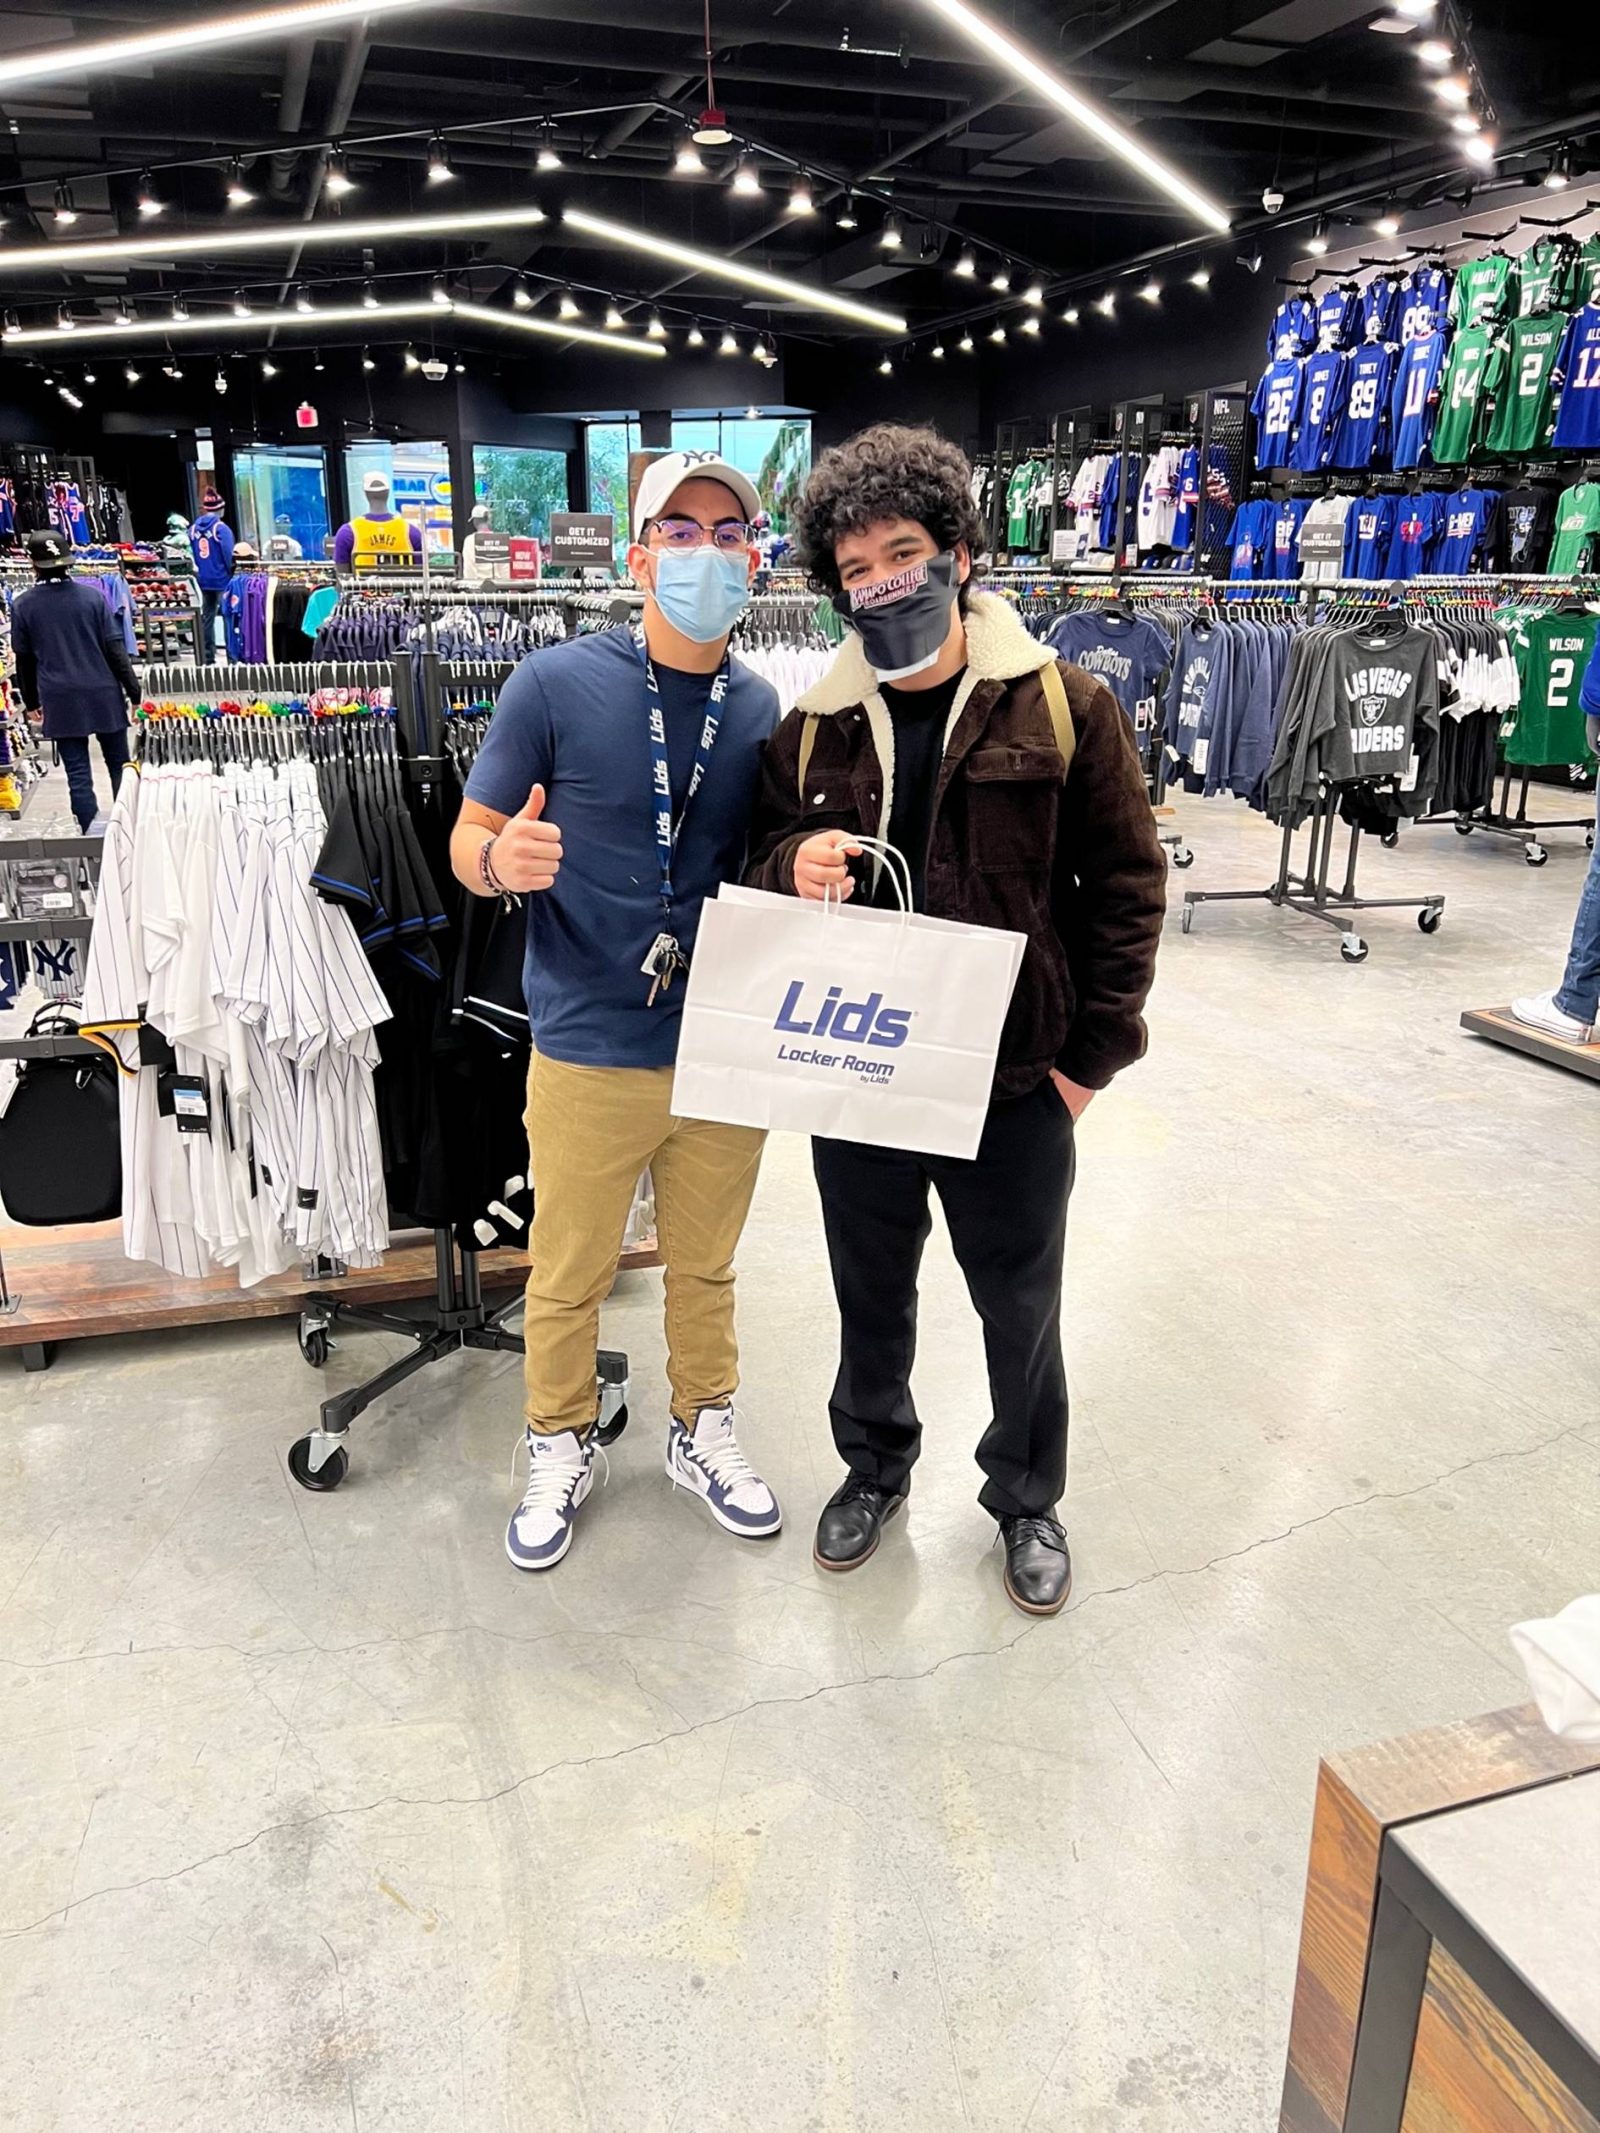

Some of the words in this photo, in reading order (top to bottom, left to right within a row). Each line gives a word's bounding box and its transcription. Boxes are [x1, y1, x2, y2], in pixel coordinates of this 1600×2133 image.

[1520, 332, 1553, 347] WILSON
[1451, 367, 1480, 409] 84
[1518, 353, 1544, 396] 2
[1213, 399, 1230, 415] NFL
[1266, 390, 1295, 435] 26
[1309, 386, 1326, 425] 8
[1349, 379, 1378, 419] 89
[199, 537, 210, 559] 9
[369, 533, 396, 547] JAMES
[554, 535, 610, 547] CUSTOMIZED
[568, 527, 586, 536] GET
[587, 527, 595, 536] IT
[850, 583, 886, 606] RAMAPO
[887, 565, 926, 591] COLLEGE
[1549, 638, 1585, 651] WILSON
[1078, 650, 1132, 681] COWBOYS
[1547, 658, 1575, 707] 2
[1344, 668, 1369, 702] LAS
[1369, 666, 1412, 698] VEGAS
[649, 708, 665, 744] Lids
[700, 714, 719, 750] Lids
[653, 759, 670, 795] Lids
[688, 762, 705, 797] Lids
[656, 811, 672, 847] Lids
[33, 939, 77, 981] NY
[773, 980, 912, 1048] Lids
[777, 1044, 841, 1068] Locker
[841, 1054, 895, 1077] Room
[859, 1075, 869, 1083] by
[869, 1075, 890, 1085] Lids
